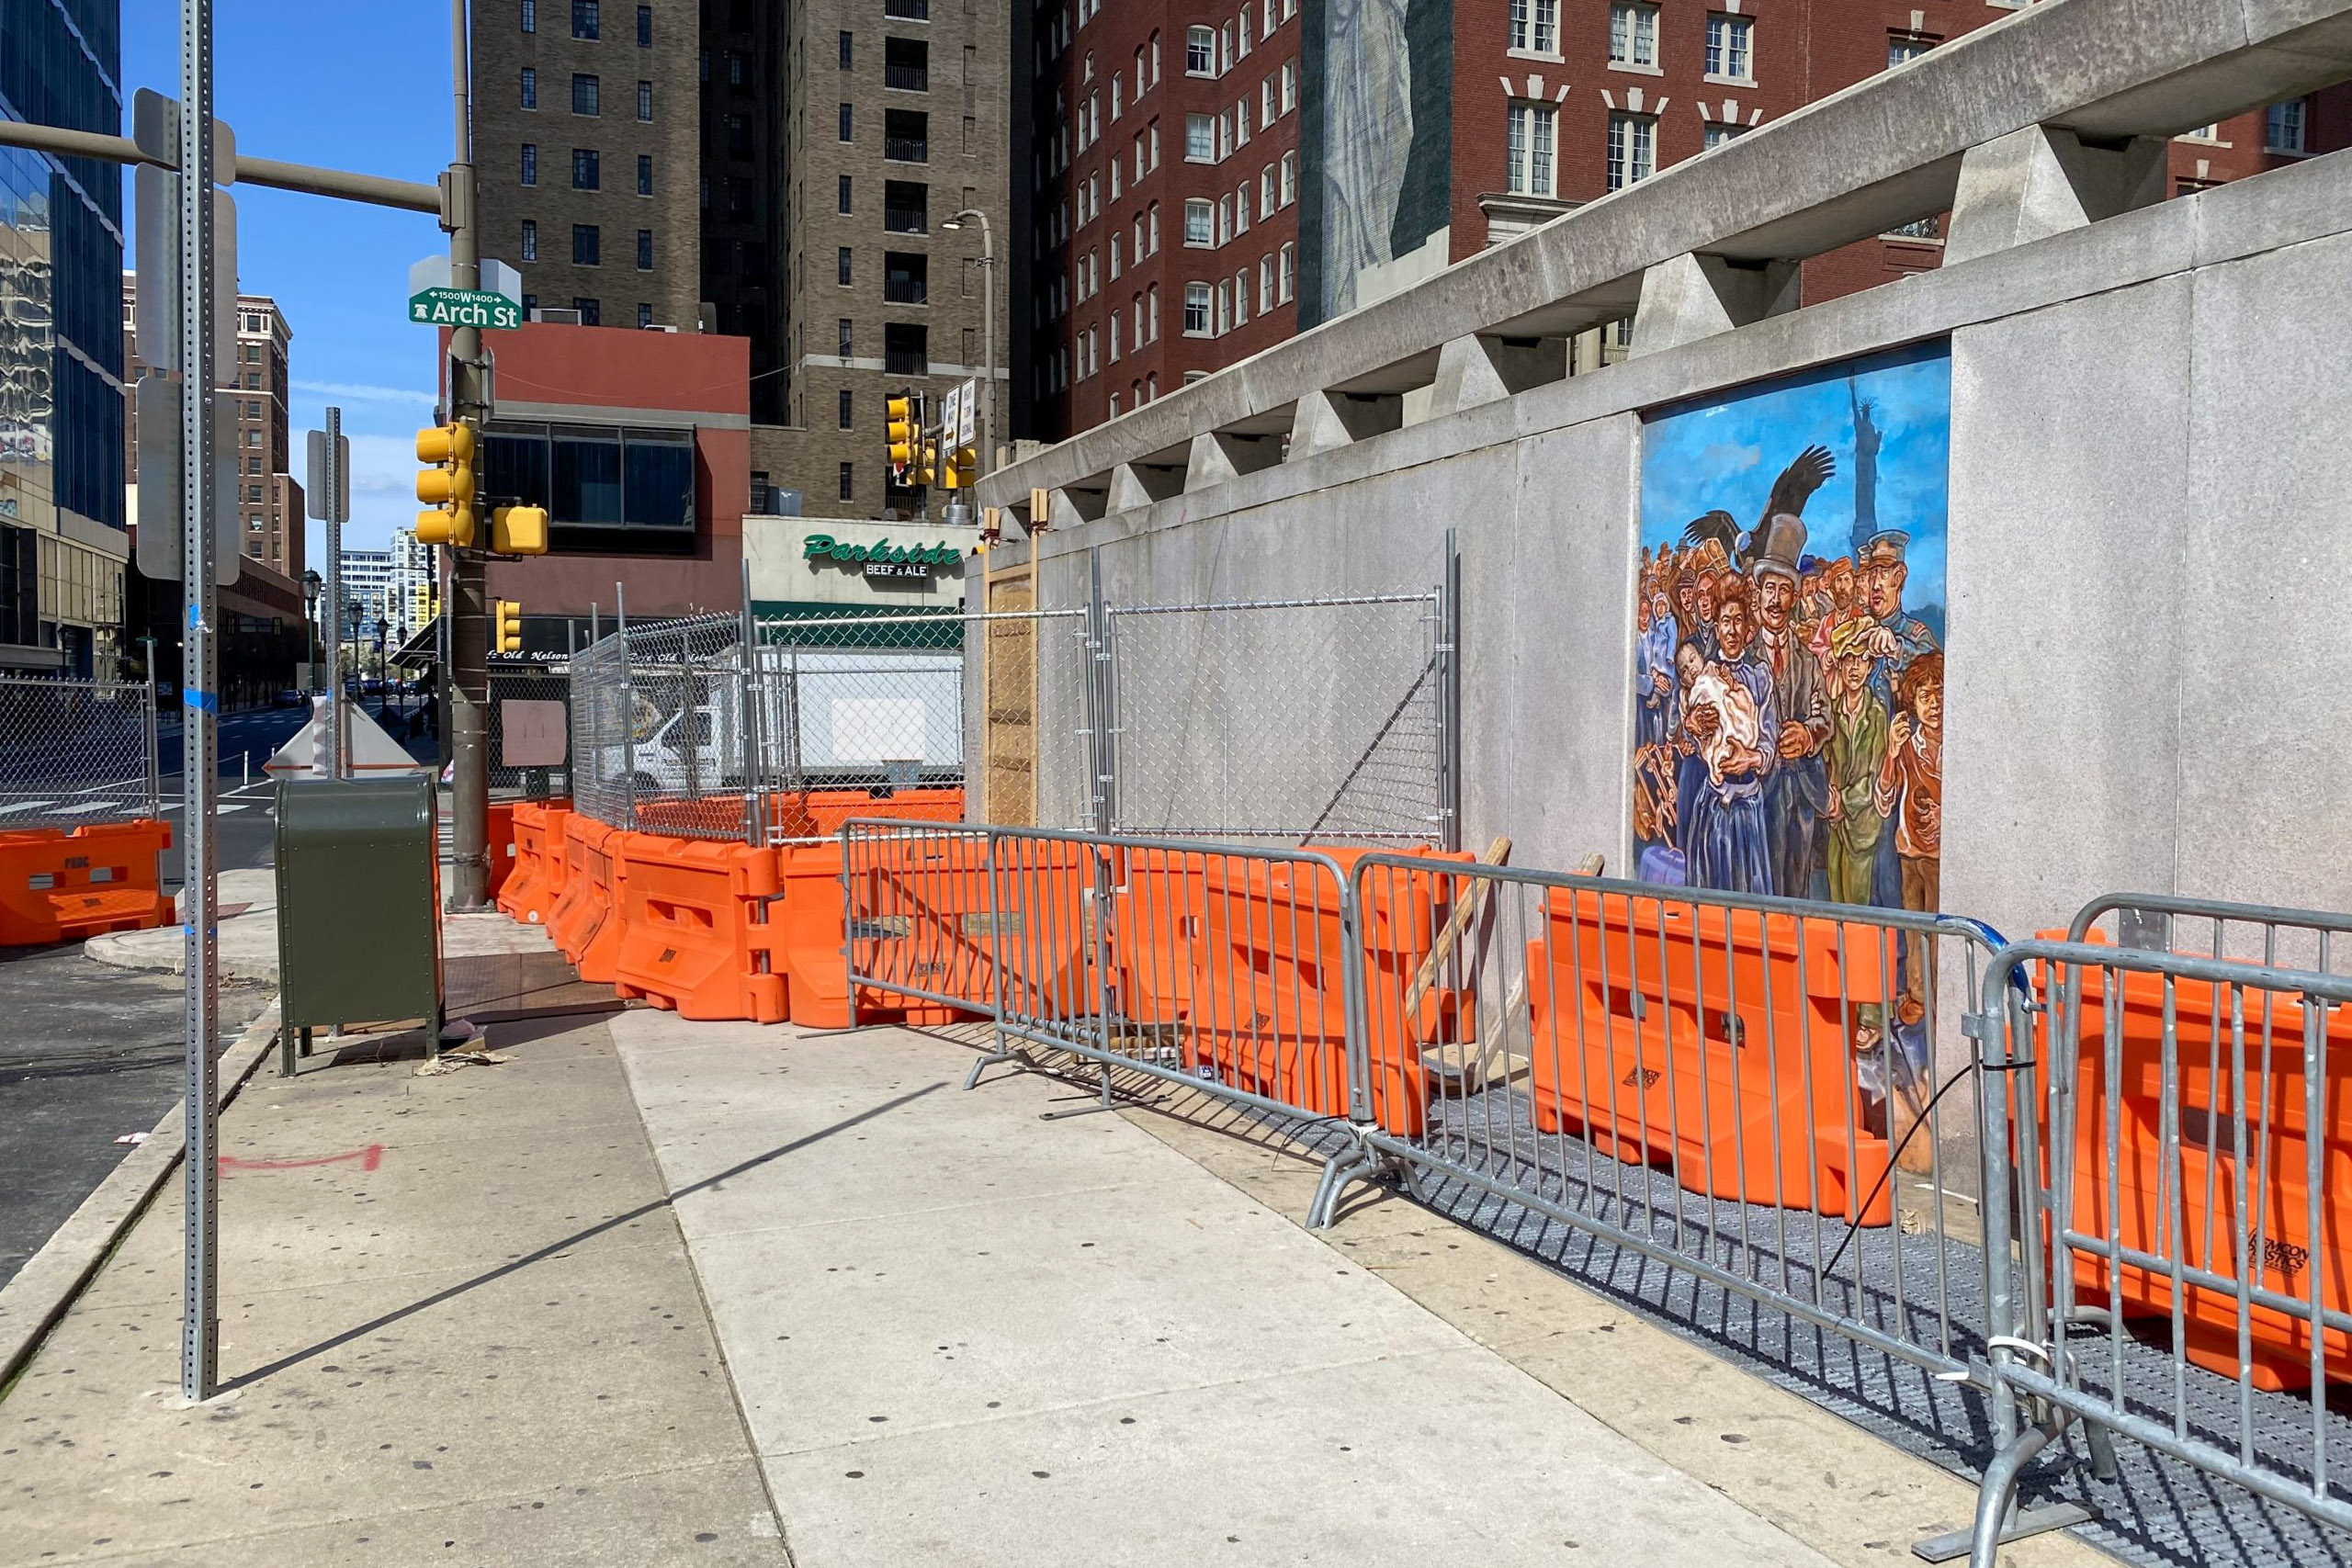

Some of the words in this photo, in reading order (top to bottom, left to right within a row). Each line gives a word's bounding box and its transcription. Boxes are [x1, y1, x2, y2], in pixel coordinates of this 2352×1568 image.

[439, 291, 460, 300] 1500
[460, 291, 471, 303] W
[471, 294, 492, 303] 1400
[432, 301, 487, 325] Arch
[493, 306, 517, 328] St
[803, 534, 961, 565] Parkside
[866, 565, 895, 575] BEEF
[897, 568, 903, 576] &
[905, 565, 927, 576] ALE
[503, 650, 525, 660] Old
[530, 650, 569, 661] Nelson
